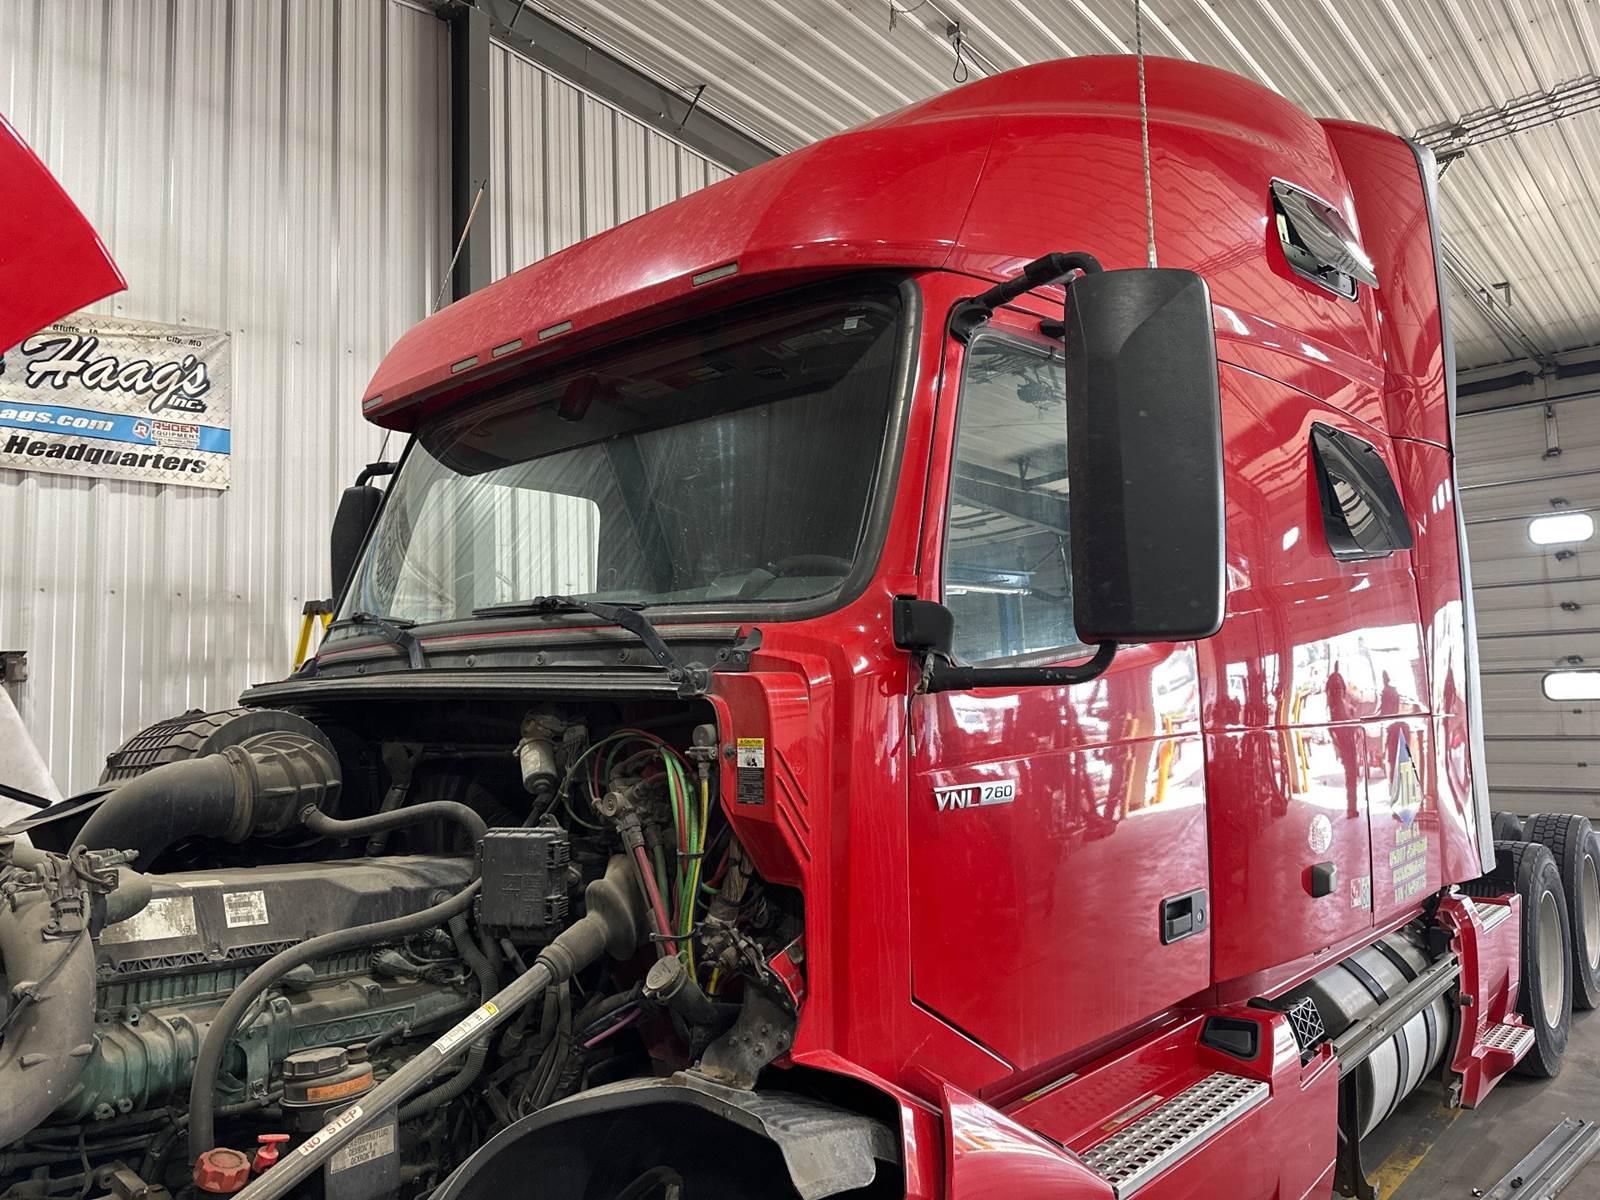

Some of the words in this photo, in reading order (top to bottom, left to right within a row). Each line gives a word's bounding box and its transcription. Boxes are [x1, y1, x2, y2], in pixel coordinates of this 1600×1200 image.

[188, 339, 202, 347] MO
[21, 333, 210, 413] Haag's
[166, 394, 208, 413] Inc.
[151, 429, 199, 439] EQUIPMENT
[152, 421, 199, 434] RYDEN
[3, 435, 207, 473] Headquarters
[934, 788, 980, 812] VNL
[984, 785, 1012, 800] 760
[298, 1010, 408, 1046] VOLVO
[303, 1137, 321, 1153] NO
[326, 1109, 357, 1134] STEP
